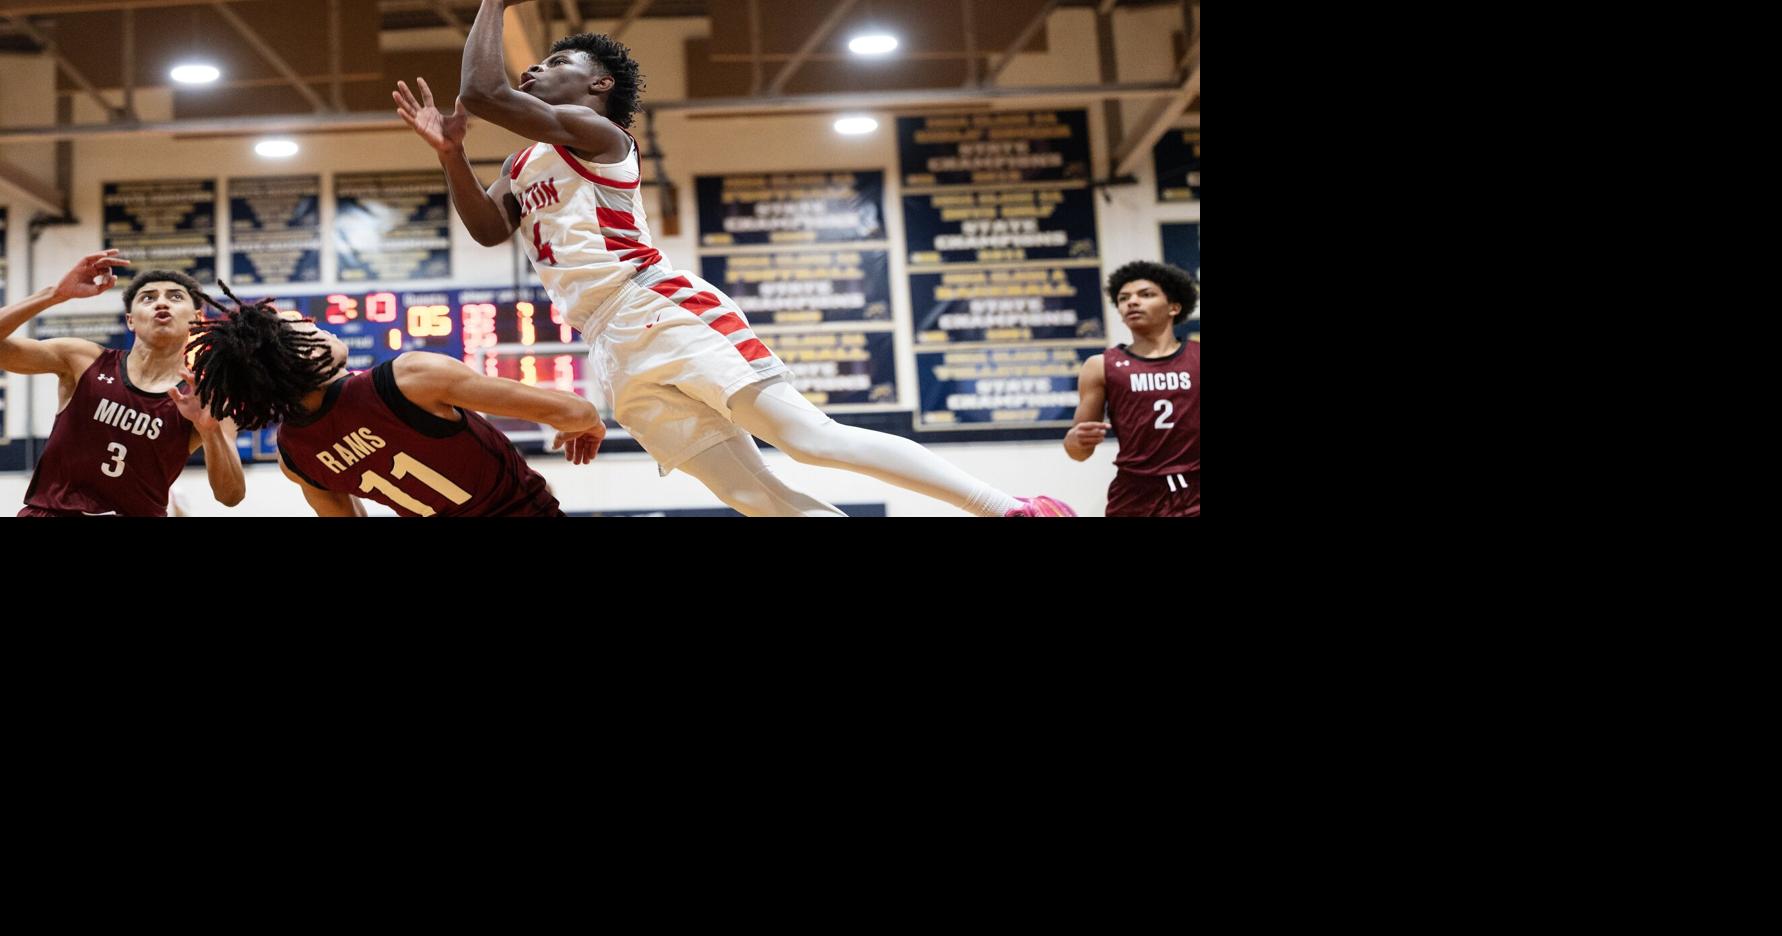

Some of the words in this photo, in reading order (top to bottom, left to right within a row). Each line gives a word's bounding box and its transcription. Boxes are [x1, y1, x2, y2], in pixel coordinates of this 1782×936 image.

[533, 222, 559, 266] 4
[1130, 371, 1192, 392] MICDS
[93, 398, 163, 440] MICDS
[1153, 399, 1175, 430] 2
[100, 441, 128, 478] 3
[315, 426, 387, 474] RAMS
[358, 451, 473, 518] 11
